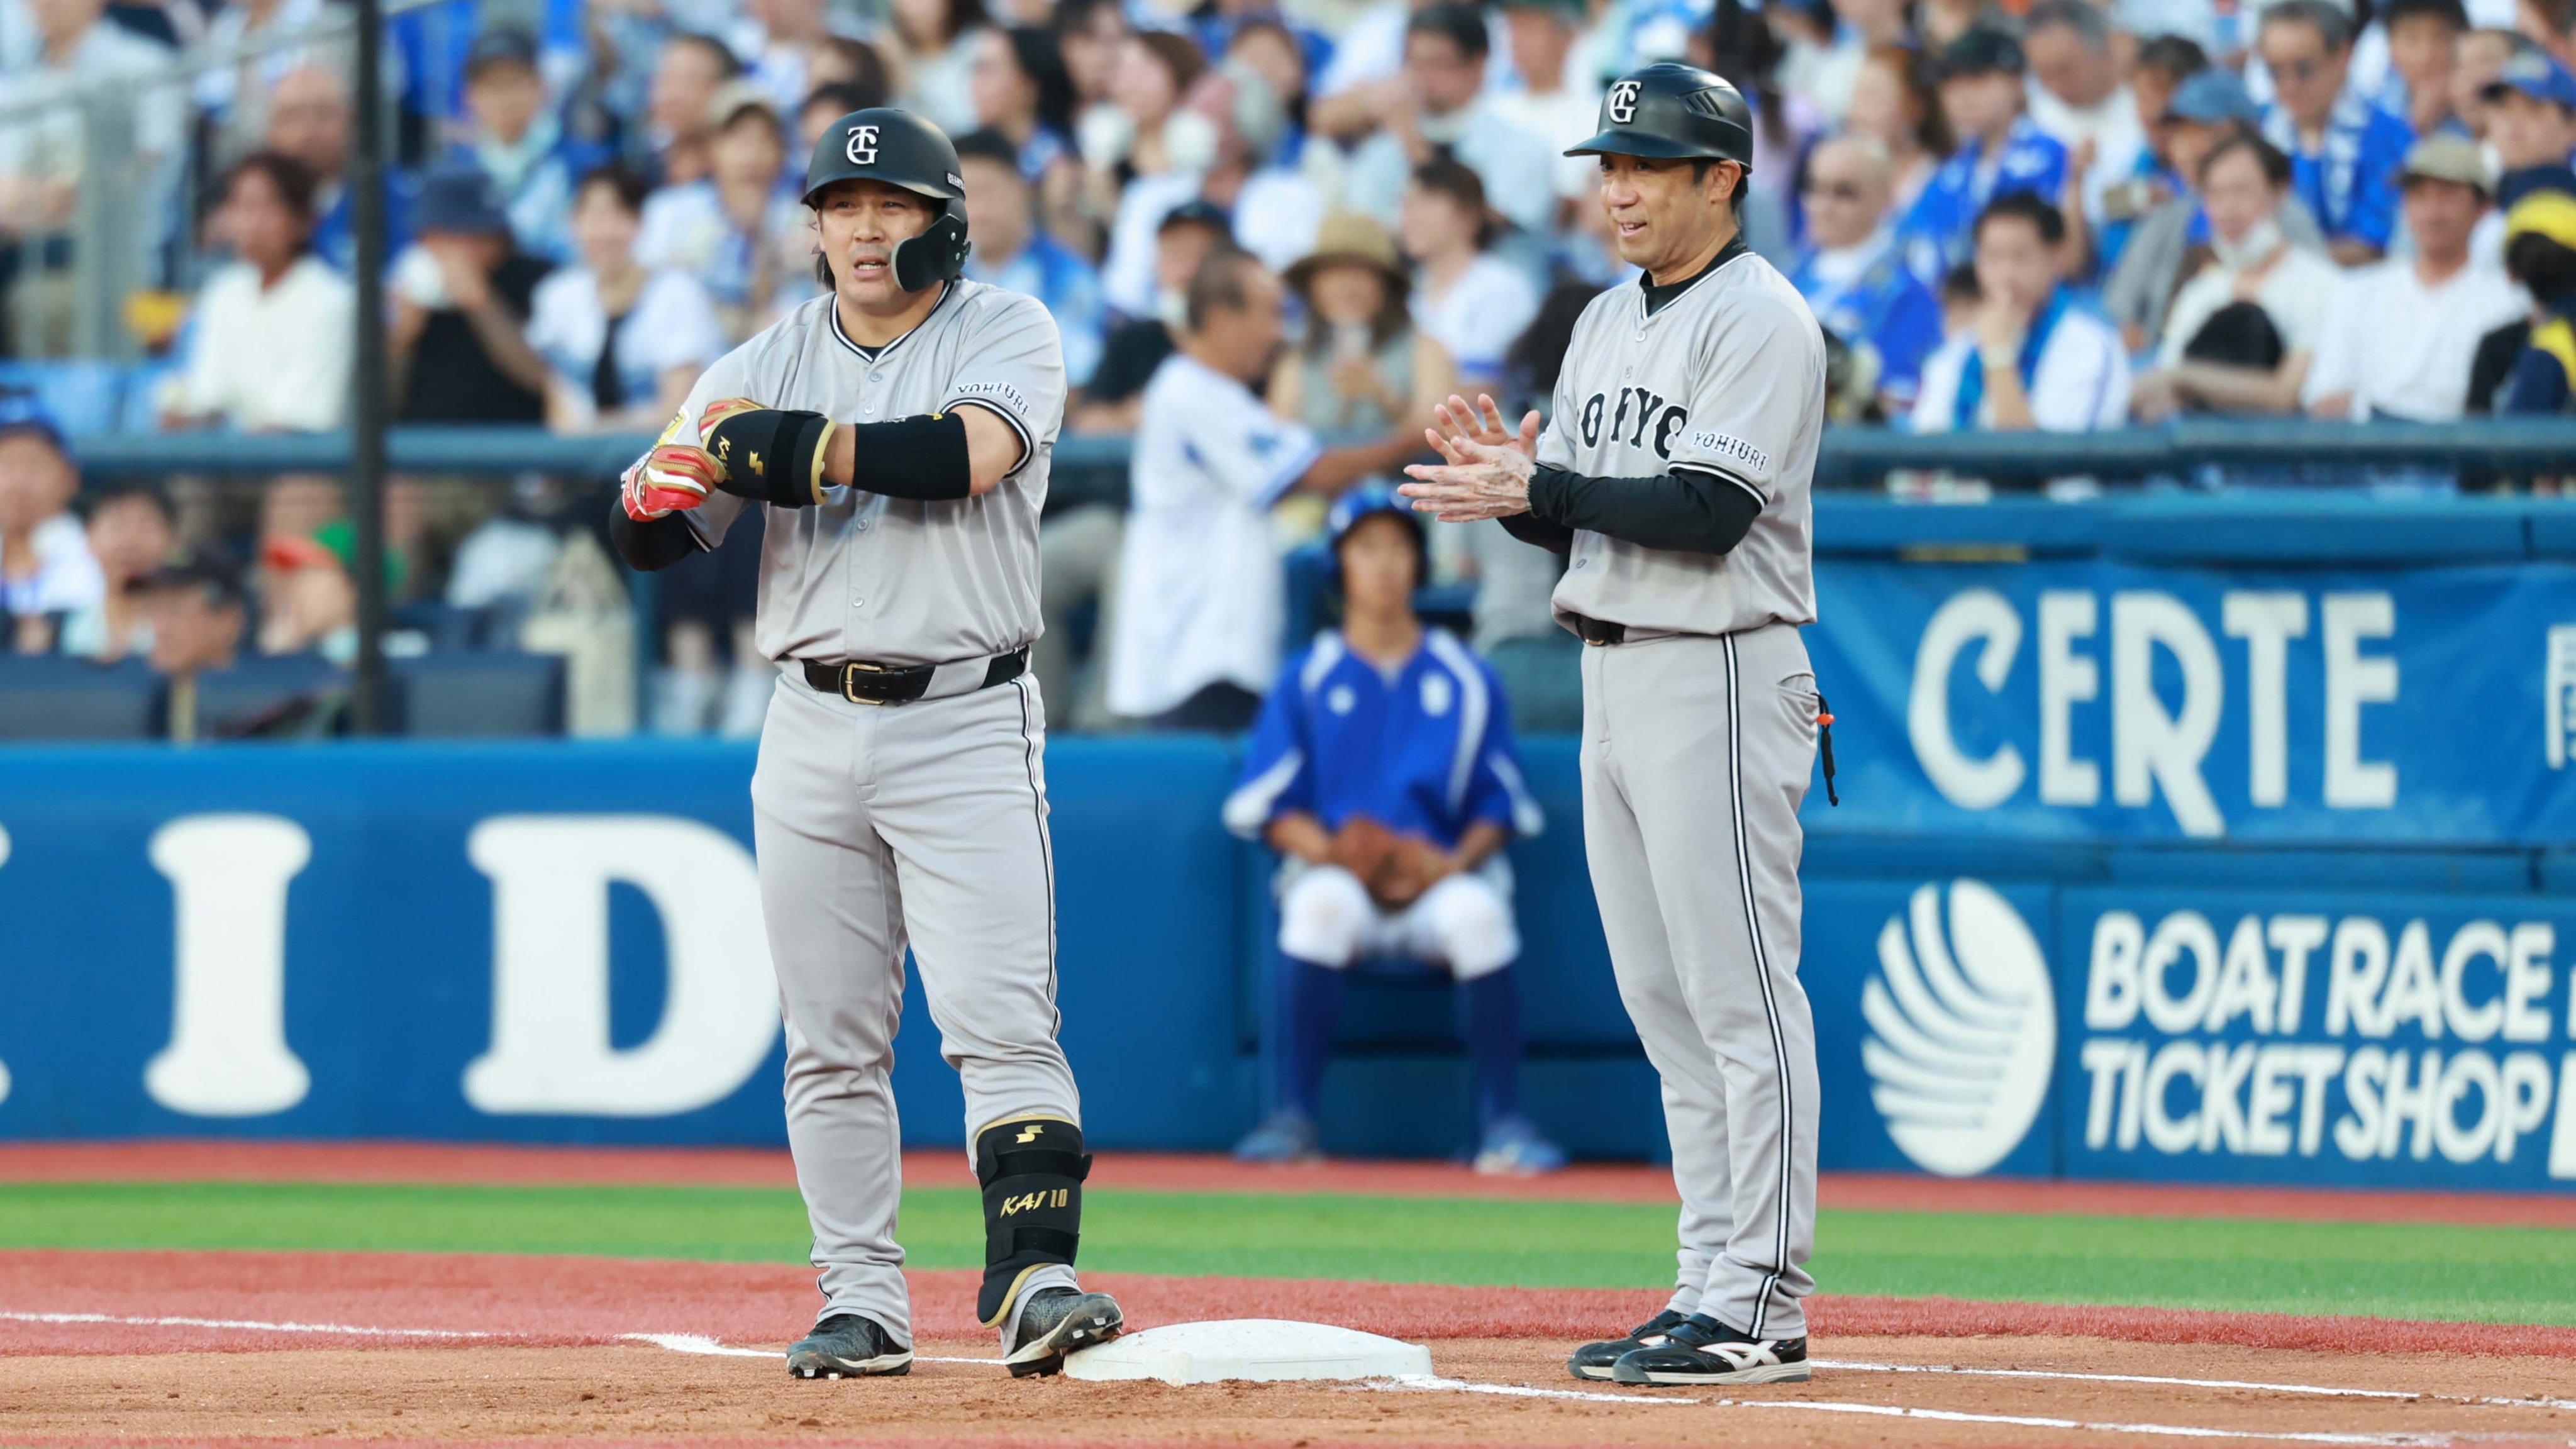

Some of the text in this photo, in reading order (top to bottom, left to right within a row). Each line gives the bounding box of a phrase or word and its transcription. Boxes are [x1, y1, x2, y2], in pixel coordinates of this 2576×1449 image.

[1908, 587, 2397, 836] CERTE
[0, 813, 783, 1117] ID
[2084, 911, 2555, 1041] BOAT RACE
[2081, 1039, 2552, 1163] TICKET SHOP
[1000, 1189, 1068, 1219] KAI 10
